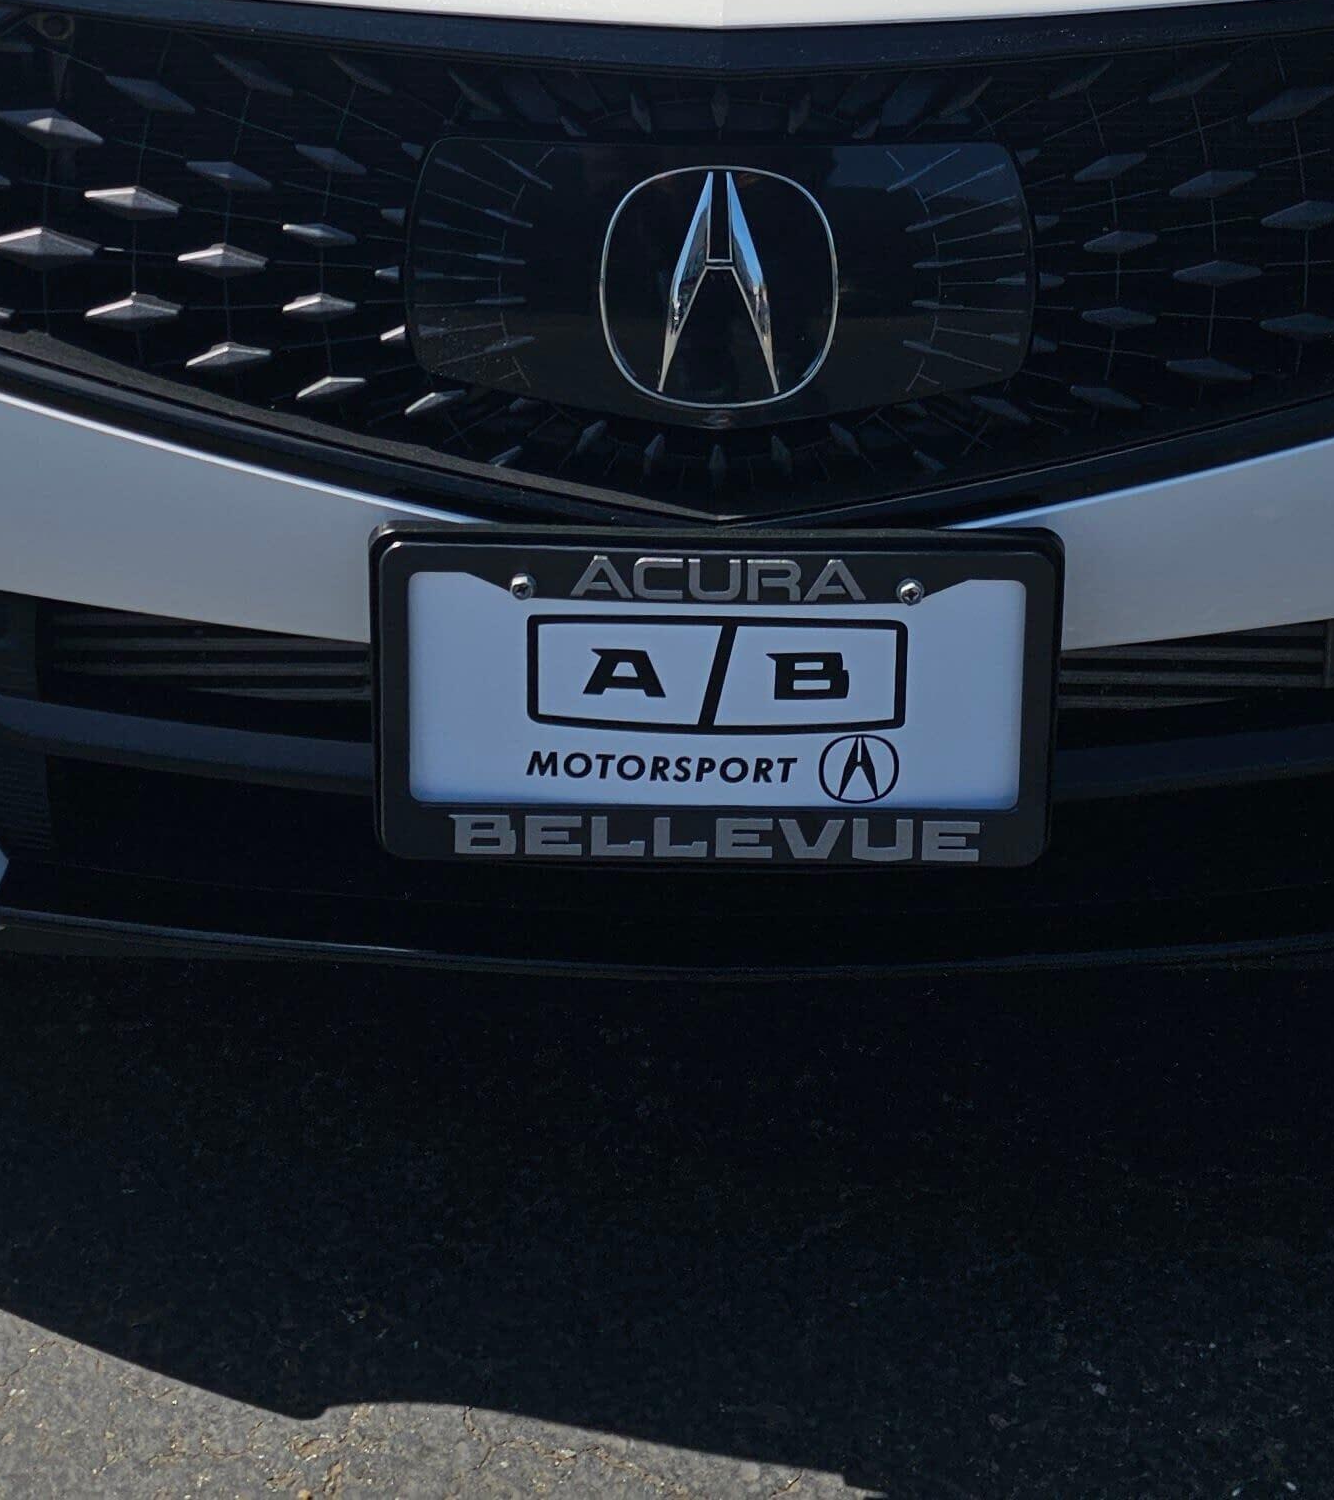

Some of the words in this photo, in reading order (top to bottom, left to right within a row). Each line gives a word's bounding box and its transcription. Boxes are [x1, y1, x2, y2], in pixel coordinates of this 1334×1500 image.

[570, 554, 867, 601] ACURA
[583, 648, 666, 698] A
[766, 651, 850, 700] B
[525, 751, 798, 784] MOTORSPORT
[449, 814, 981, 862] BELLEVUE
